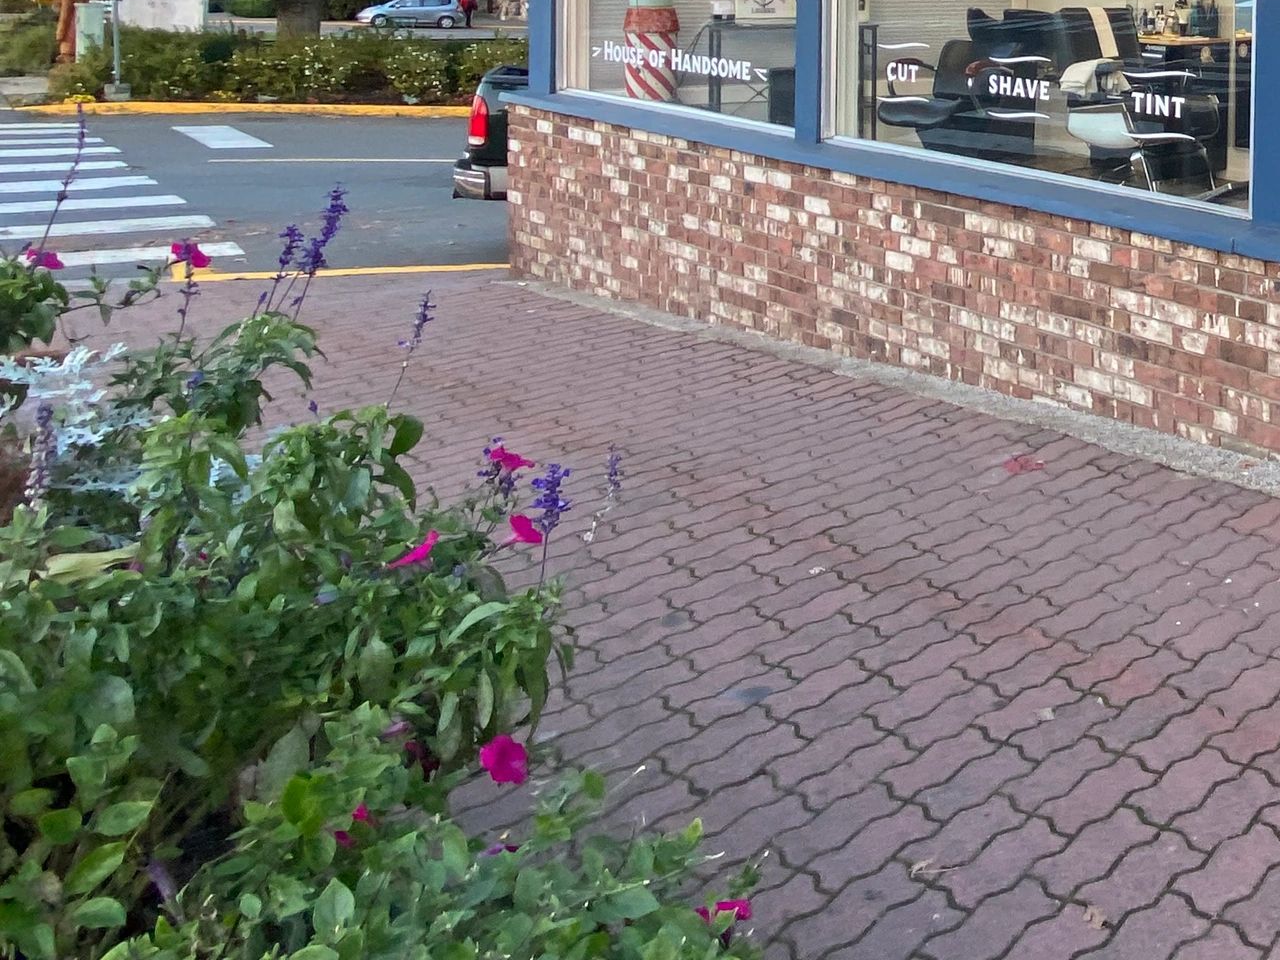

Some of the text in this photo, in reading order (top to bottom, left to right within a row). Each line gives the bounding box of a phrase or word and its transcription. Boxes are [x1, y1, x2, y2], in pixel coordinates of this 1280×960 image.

[604, 40, 751, 81] HOUSE OF HANDSOME
[886, 61, 919, 83] CUT
[988, 74, 1050, 101] SHAVE
[1131, 91, 1186, 119] TINT
